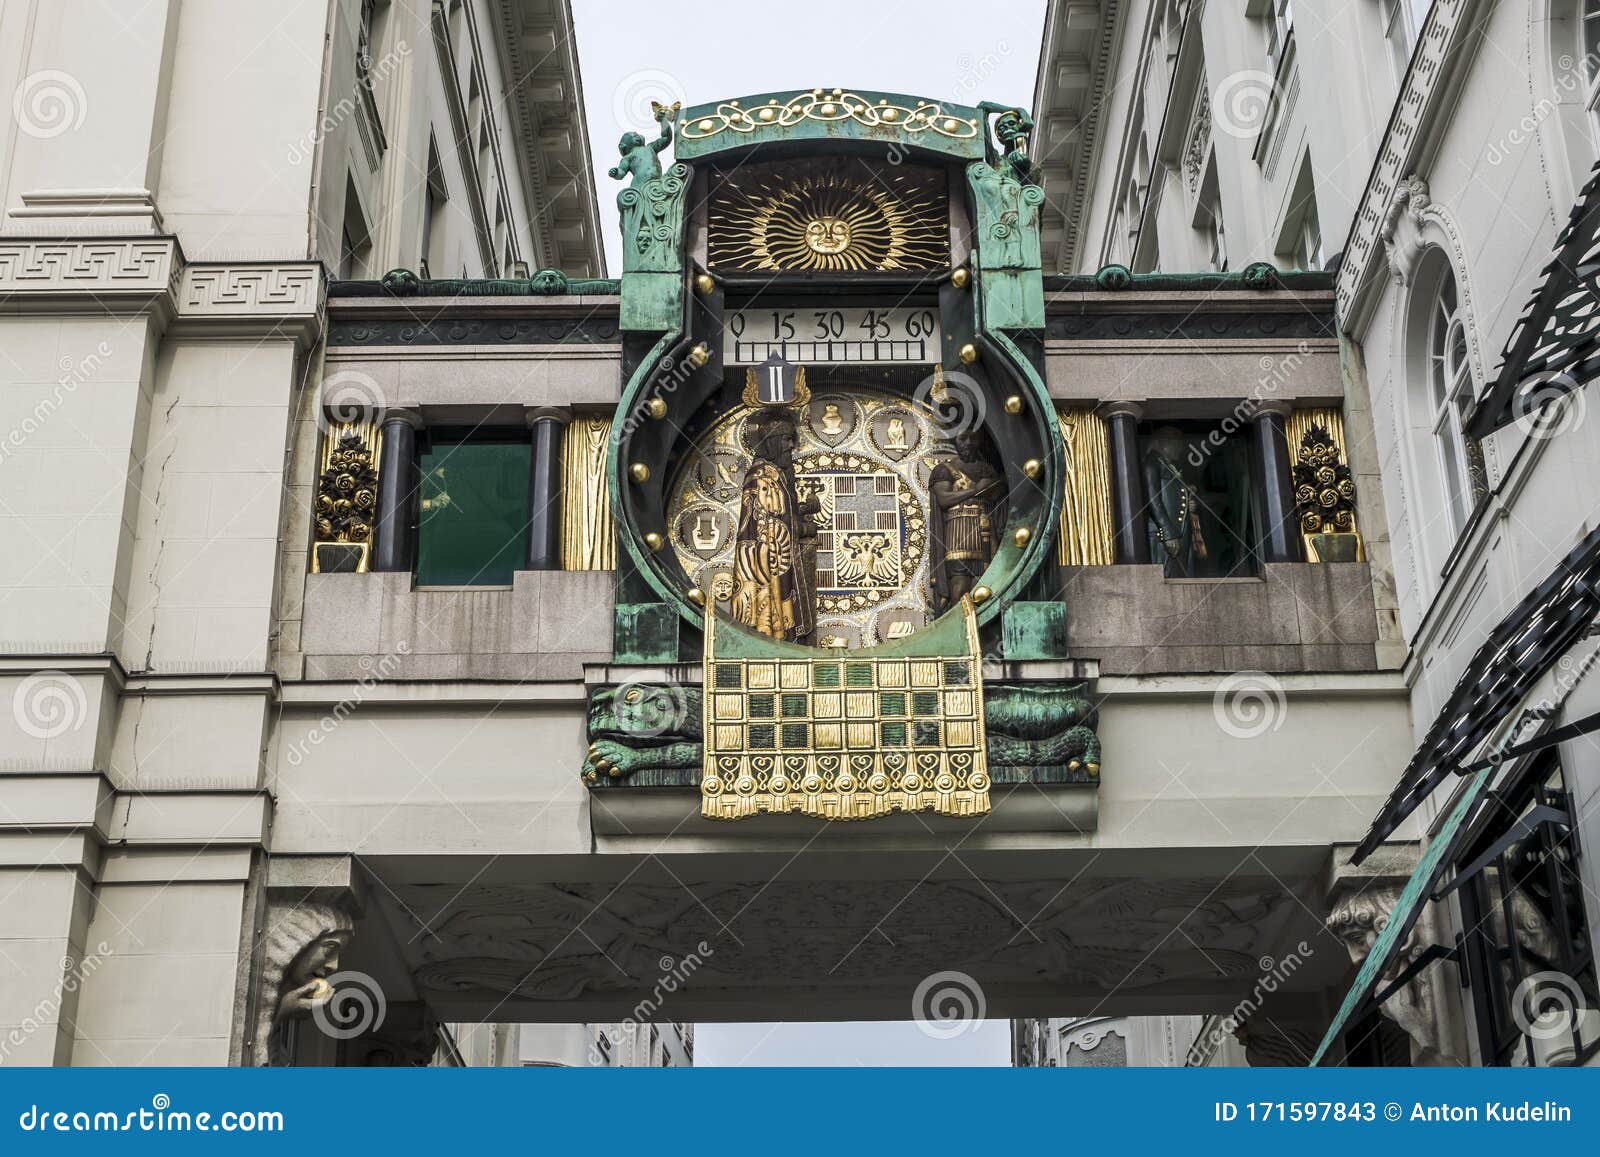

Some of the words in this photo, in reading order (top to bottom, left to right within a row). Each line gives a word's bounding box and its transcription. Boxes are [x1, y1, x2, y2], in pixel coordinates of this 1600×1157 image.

[730, 311, 745, 338] 0
[771, 311, 796, 340] 15
[813, 310, 845, 340] 30
[858, 310, 891, 340] 45
[904, 310, 935, 338] 60
